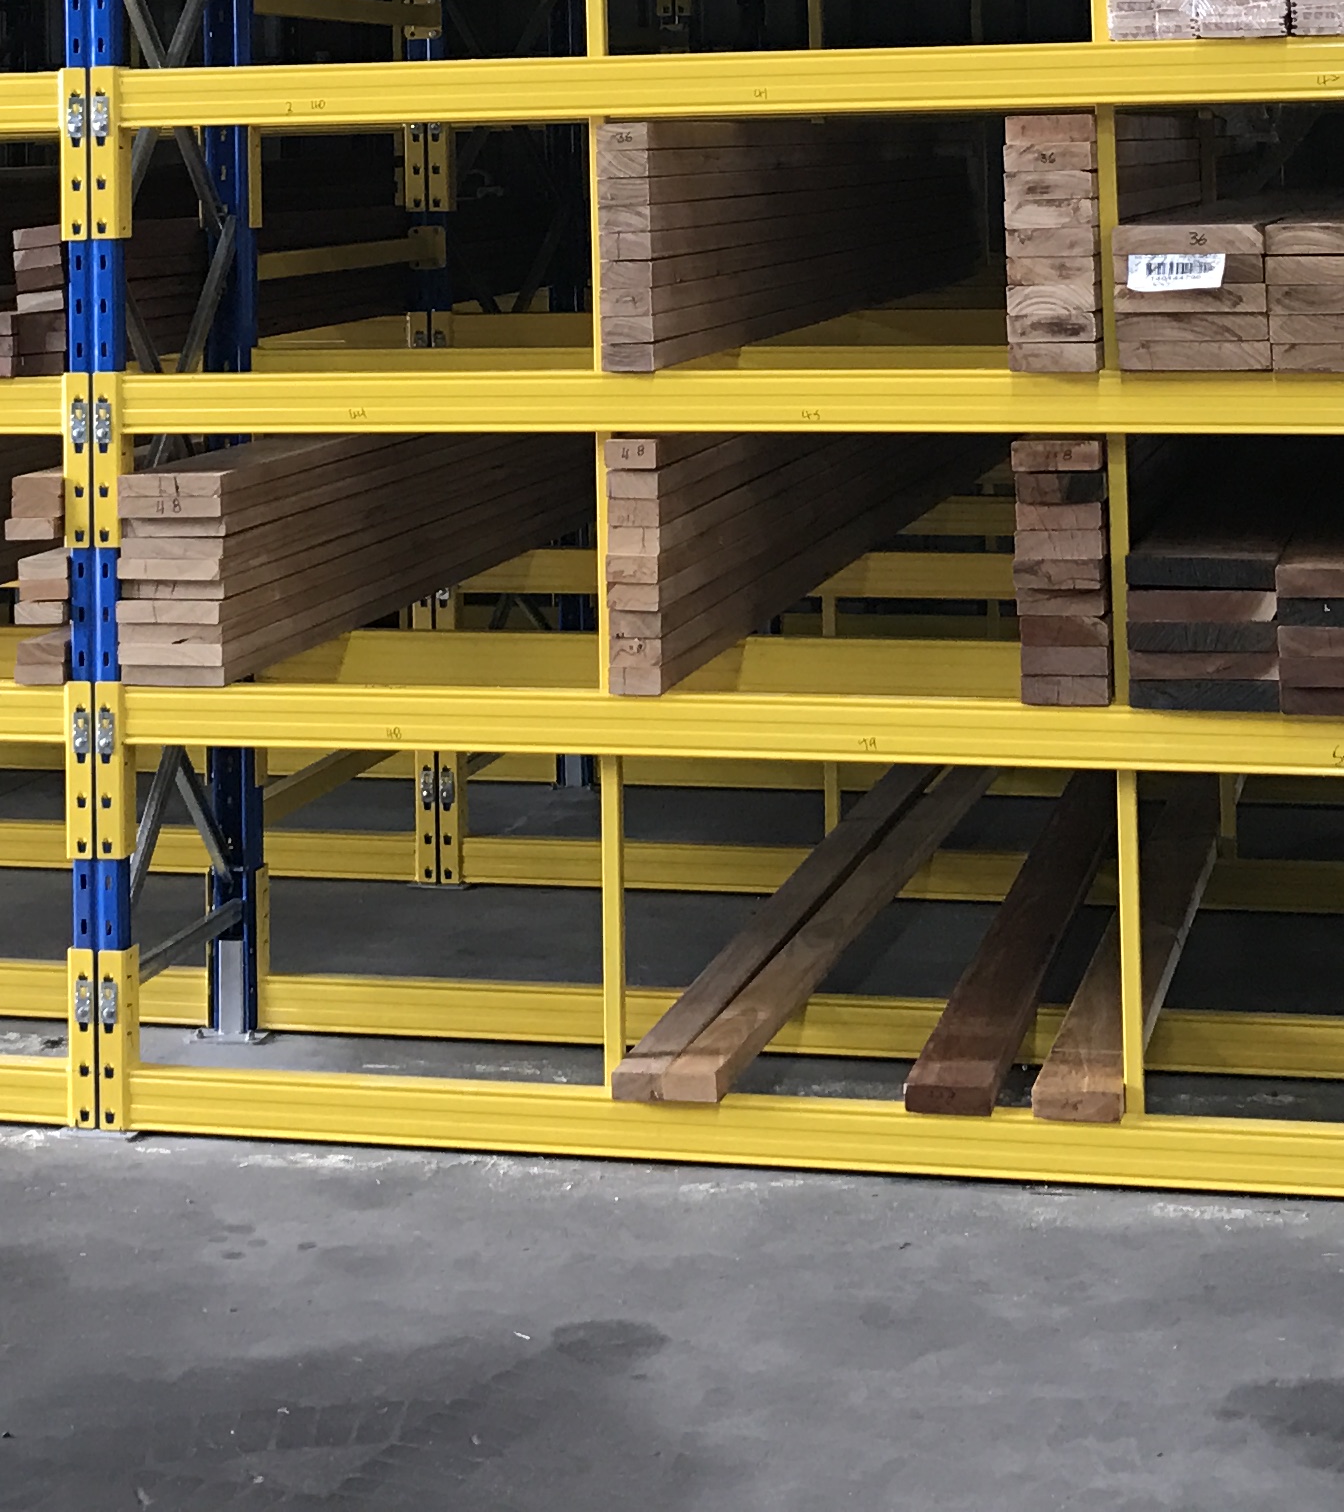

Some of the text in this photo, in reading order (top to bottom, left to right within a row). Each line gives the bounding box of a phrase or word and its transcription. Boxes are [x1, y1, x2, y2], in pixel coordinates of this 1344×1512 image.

[616, 132, 634, 143] 36
[1040, 152, 1056, 164] 36
[1189, 231, 1208, 246] 36
